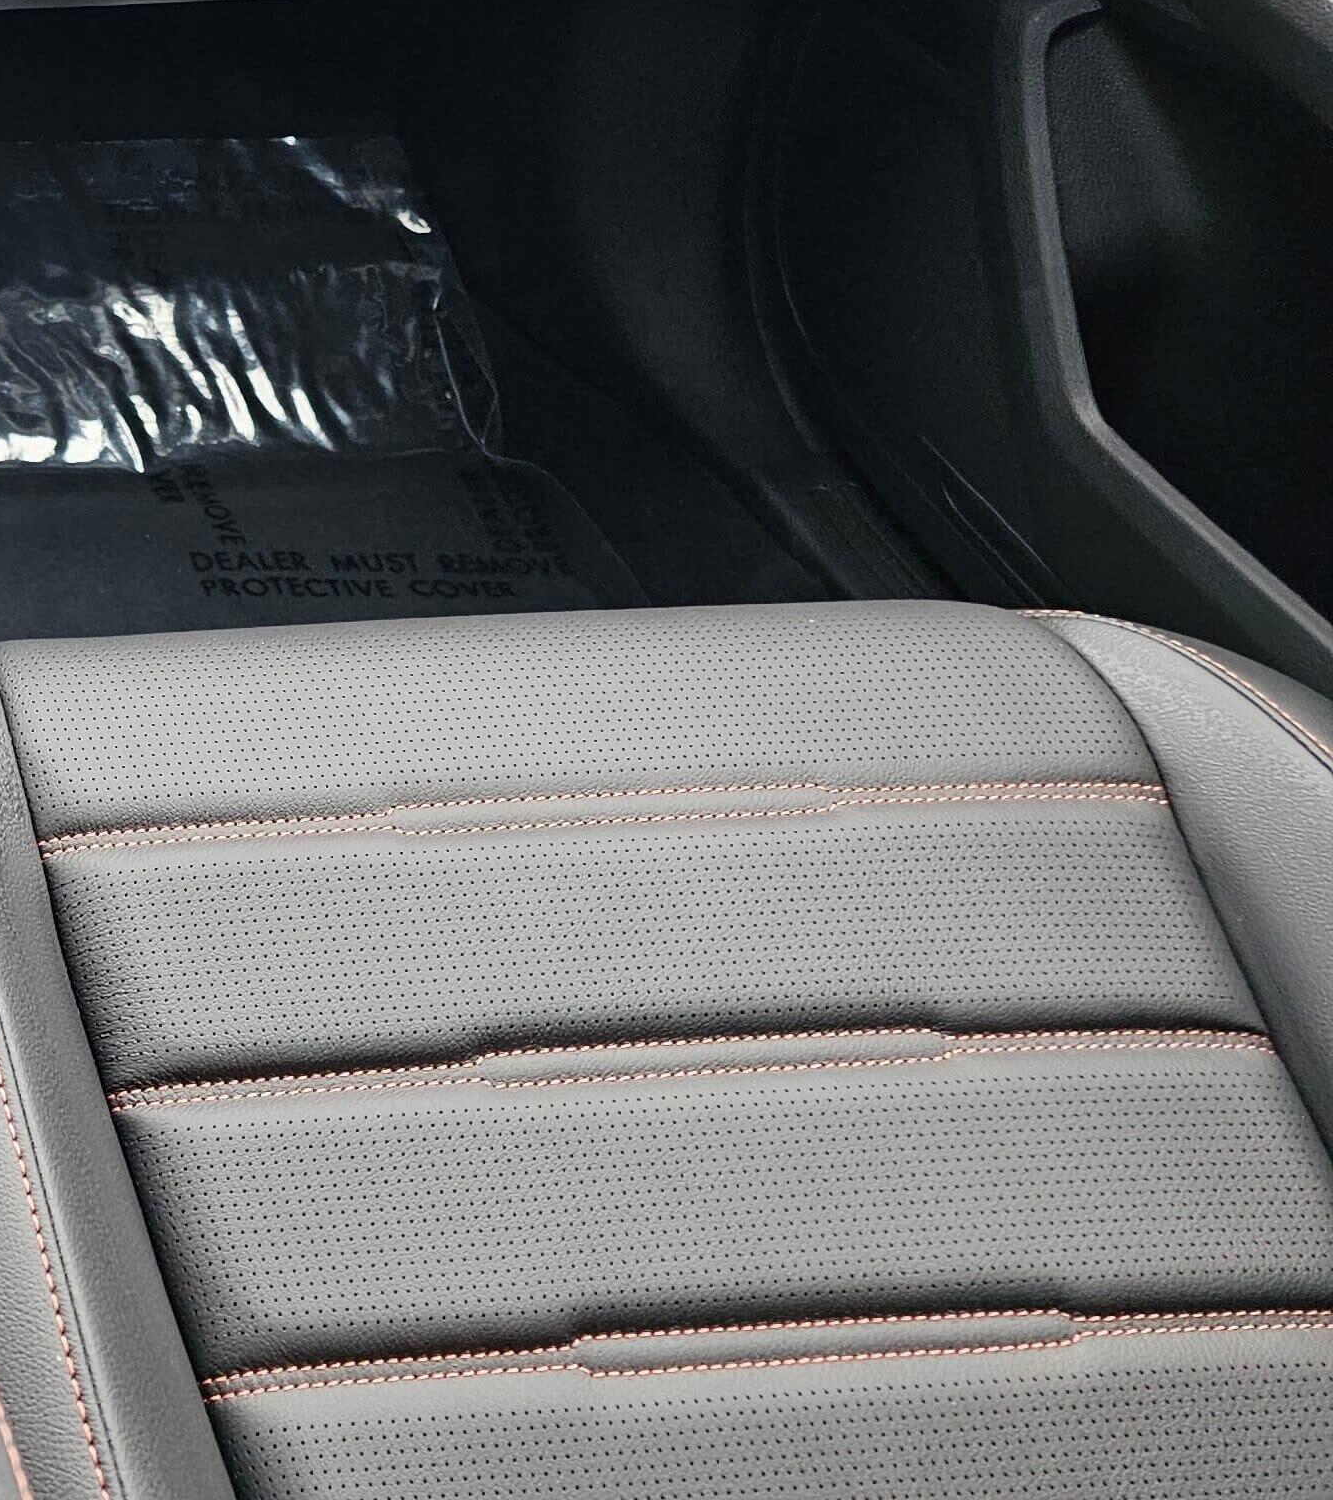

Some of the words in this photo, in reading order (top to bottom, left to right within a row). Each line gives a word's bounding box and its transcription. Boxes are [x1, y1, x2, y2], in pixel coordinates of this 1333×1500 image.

[189, 550, 310, 574] DEALER
[330, 552, 420, 575] MUST
[200, 577, 392, 599] PROTECTIVE
[409, 579, 517, 598] COVER
